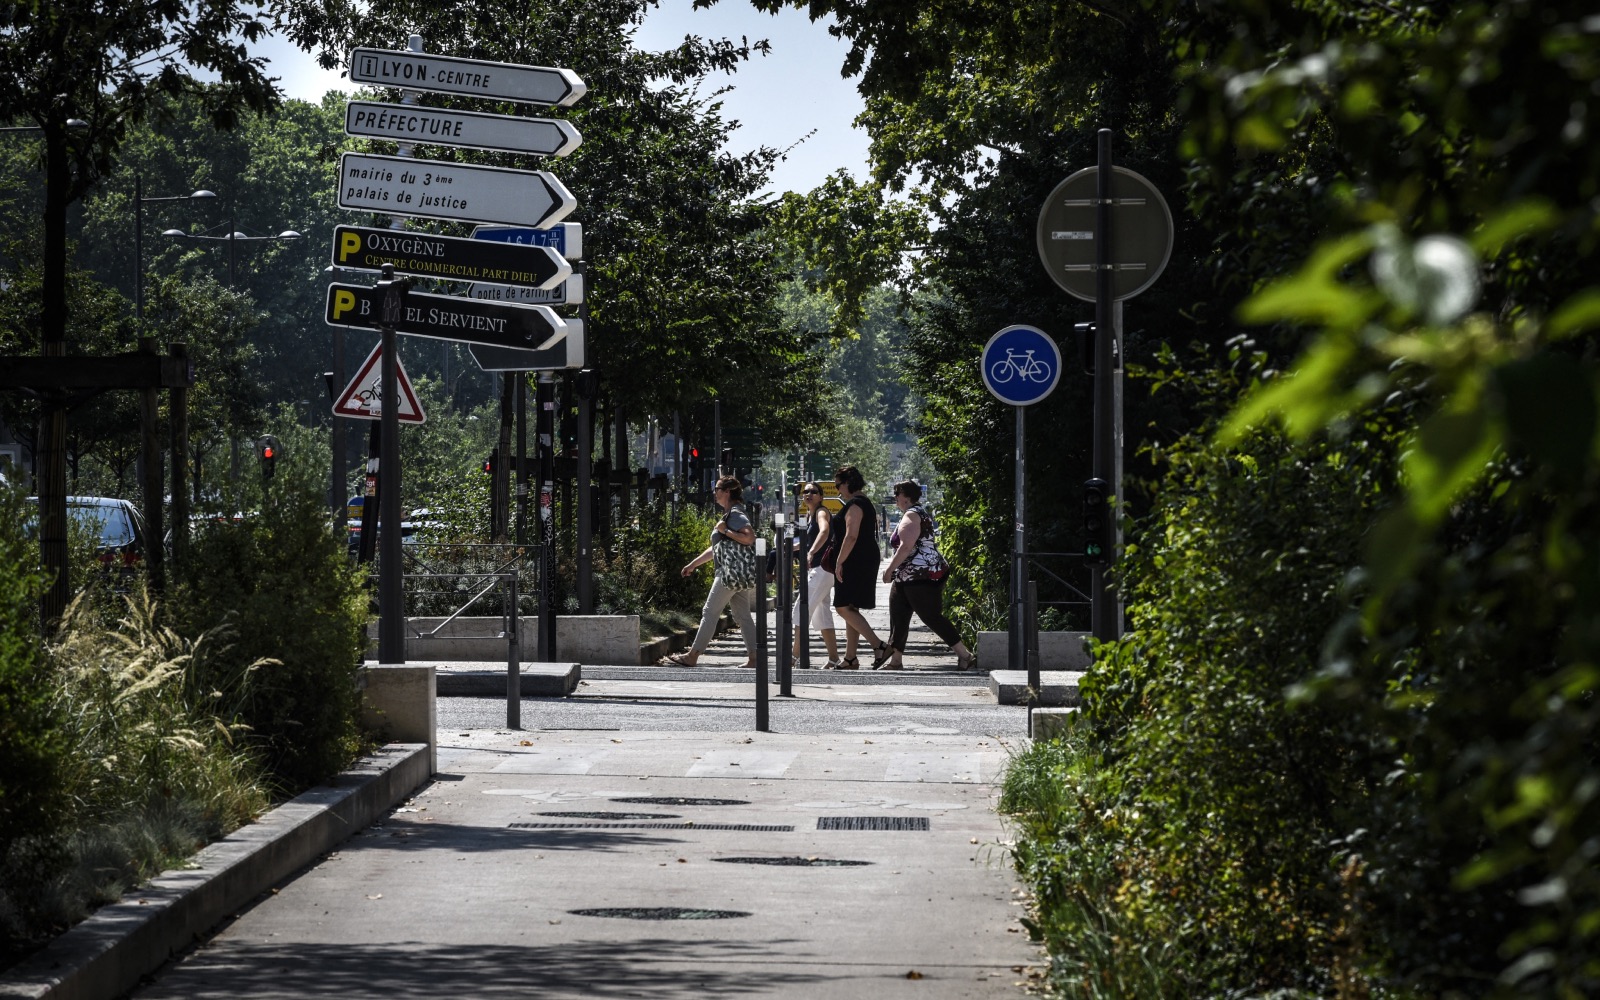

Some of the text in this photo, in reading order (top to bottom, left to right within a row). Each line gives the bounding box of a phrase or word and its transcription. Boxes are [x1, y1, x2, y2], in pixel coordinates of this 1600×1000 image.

[354, 109, 463, 137] PRÉFECTURE
[349, 167, 393, 182] mairie
[400, 171, 416, 185] du
[347, 186, 467, 210] palais de justice
[340, 231, 445, 263] P OXYGÈNE
[365, 254, 538, 283] CENTRE COMMERCIAL PART DIEU
[505, 286, 516, 299] de
[333, 289, 356, 320] P
[428, 308, 507, 333] SERVIENT
